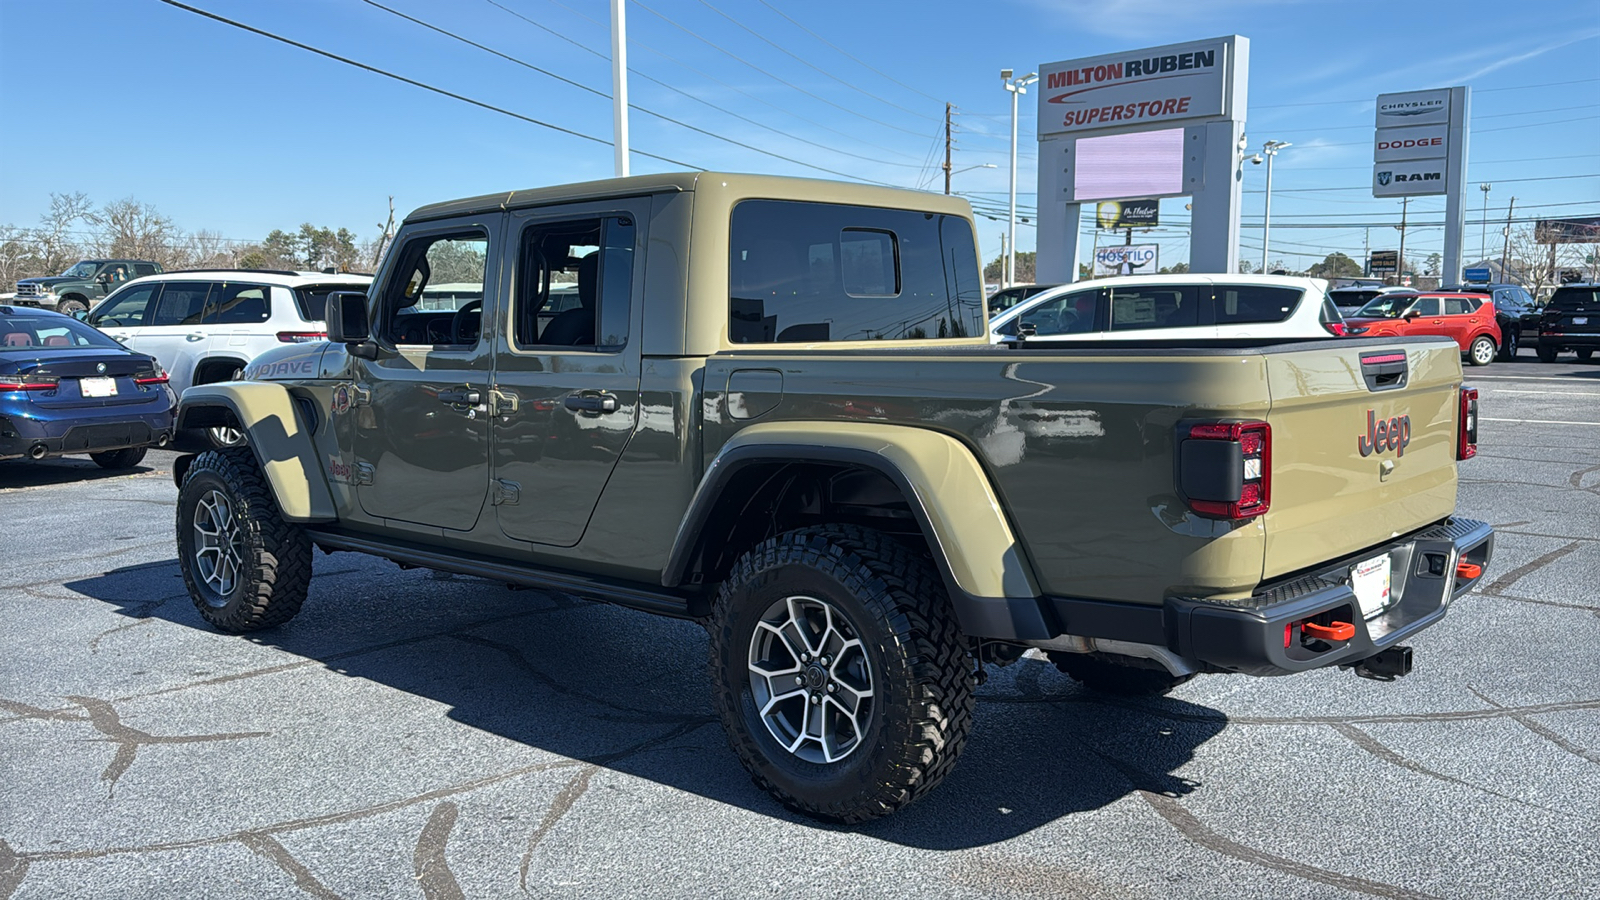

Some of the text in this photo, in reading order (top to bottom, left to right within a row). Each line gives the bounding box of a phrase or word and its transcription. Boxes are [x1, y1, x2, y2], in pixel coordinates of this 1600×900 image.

[1063, 97, 1191, 126] SUPERSTORE
[1380, 100, 1443, 110] CHRYSLER
[1377, 137, 1443, 150] DODGE
[1394, 172, 1441, 182] RAM
[1097, 250, 1154, 262] HOSTILO
[246, 361, 313, 379] MOJAVE
[1358, 408, 1411, 458] Jeep
